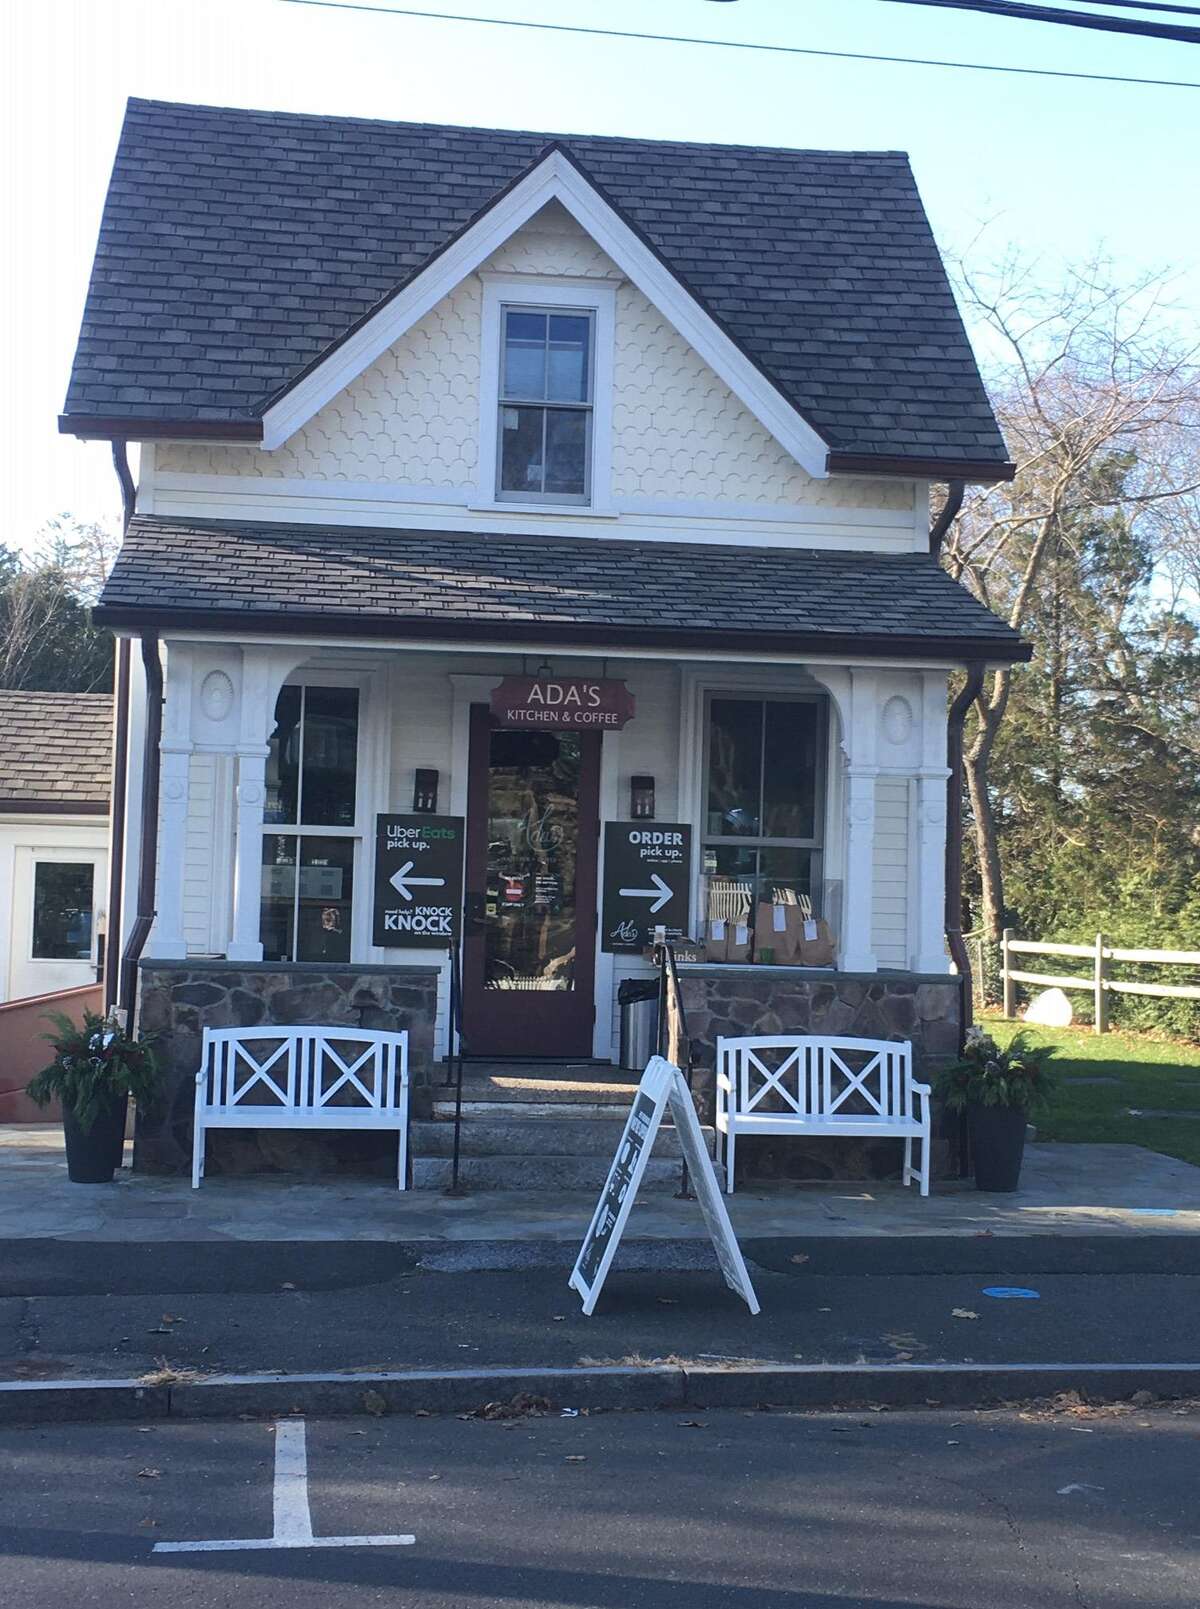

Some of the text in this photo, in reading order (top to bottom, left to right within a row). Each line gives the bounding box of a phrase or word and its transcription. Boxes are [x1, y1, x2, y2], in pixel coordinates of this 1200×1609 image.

[527, 684, 601, 707] ADA'S
[507, 709, 619, 724] KITCHEN & COFFEE
[387, 838, 430, 851] pick up.
[629, 831, 683, 845] ORDER
[640, 845, 682, 859] pick up.
[415, 906, 453, 916] KNOCK
[384, 914, 452, 931] KNOCK
[673, 950, 696, 962] inks
